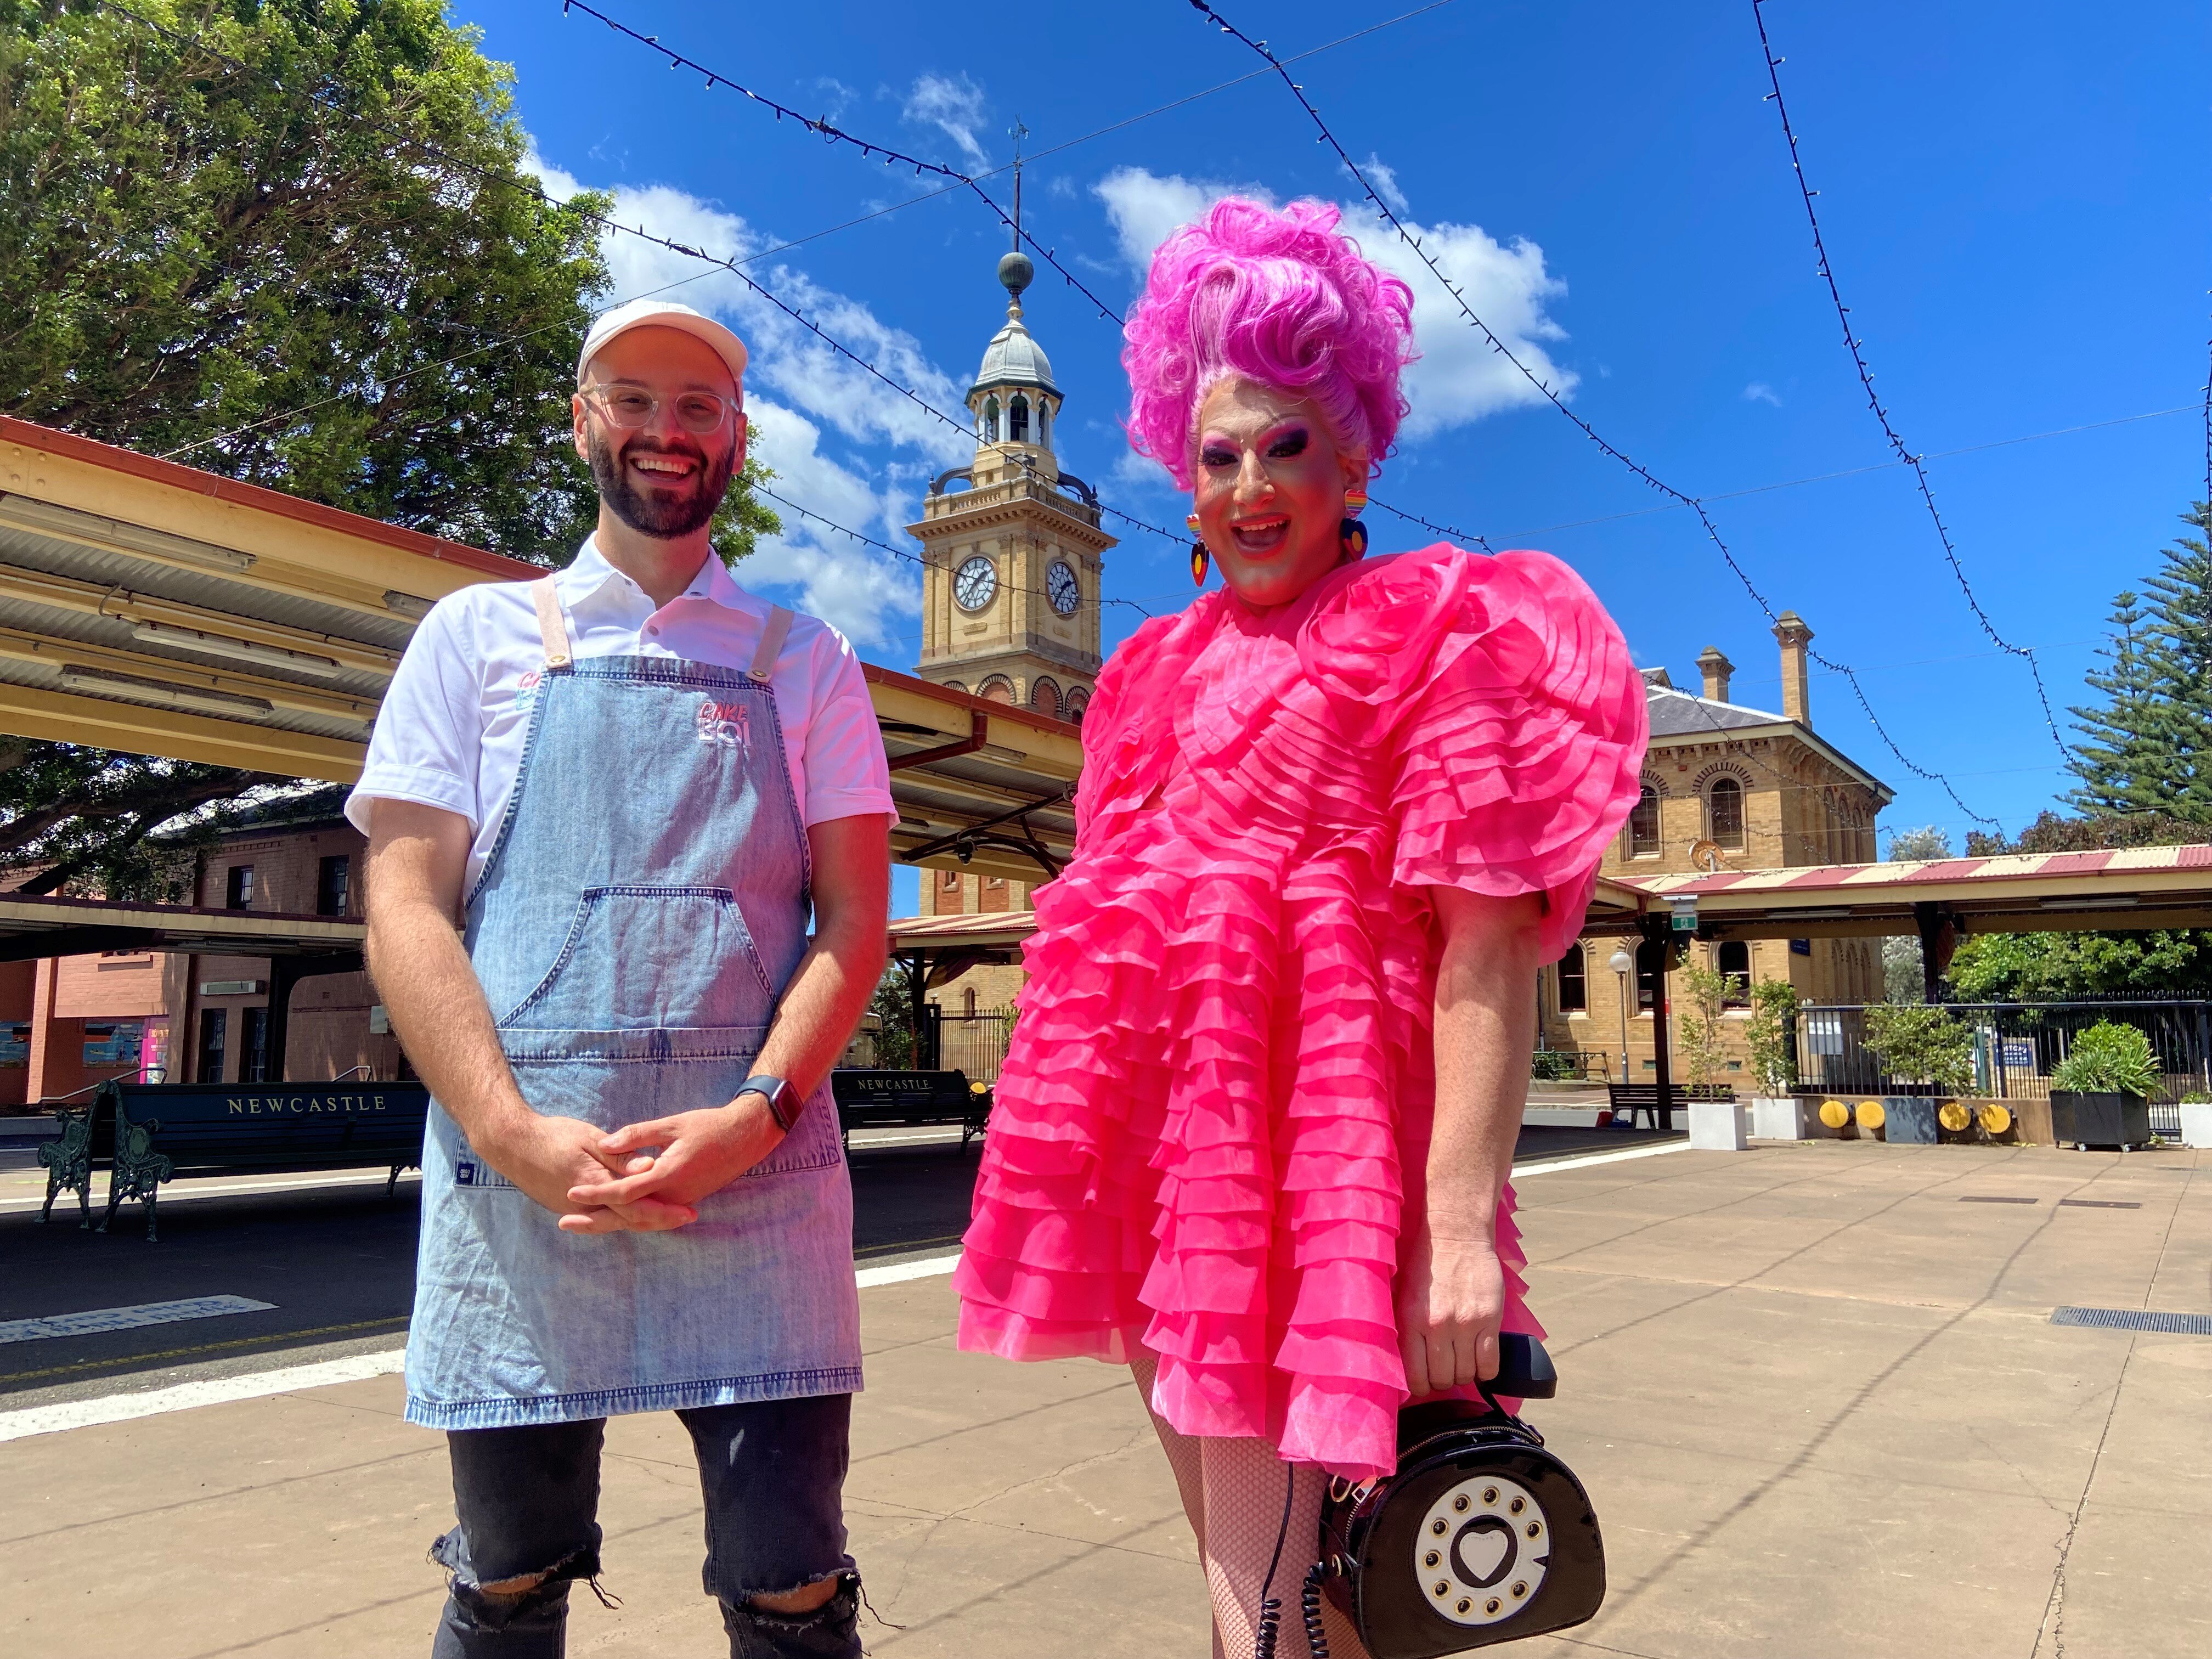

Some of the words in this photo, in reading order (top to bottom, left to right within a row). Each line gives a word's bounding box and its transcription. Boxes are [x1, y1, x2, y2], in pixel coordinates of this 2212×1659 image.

[699, 702, 748, 722] CAKE
[698, 718, 751, 746] BOI
[857, 1080, 929, 1090] NEWCASTLE
[227, 1096, 386, 1114] NEWCASTLE
[1457, 1499, 1462, 1507] 3
